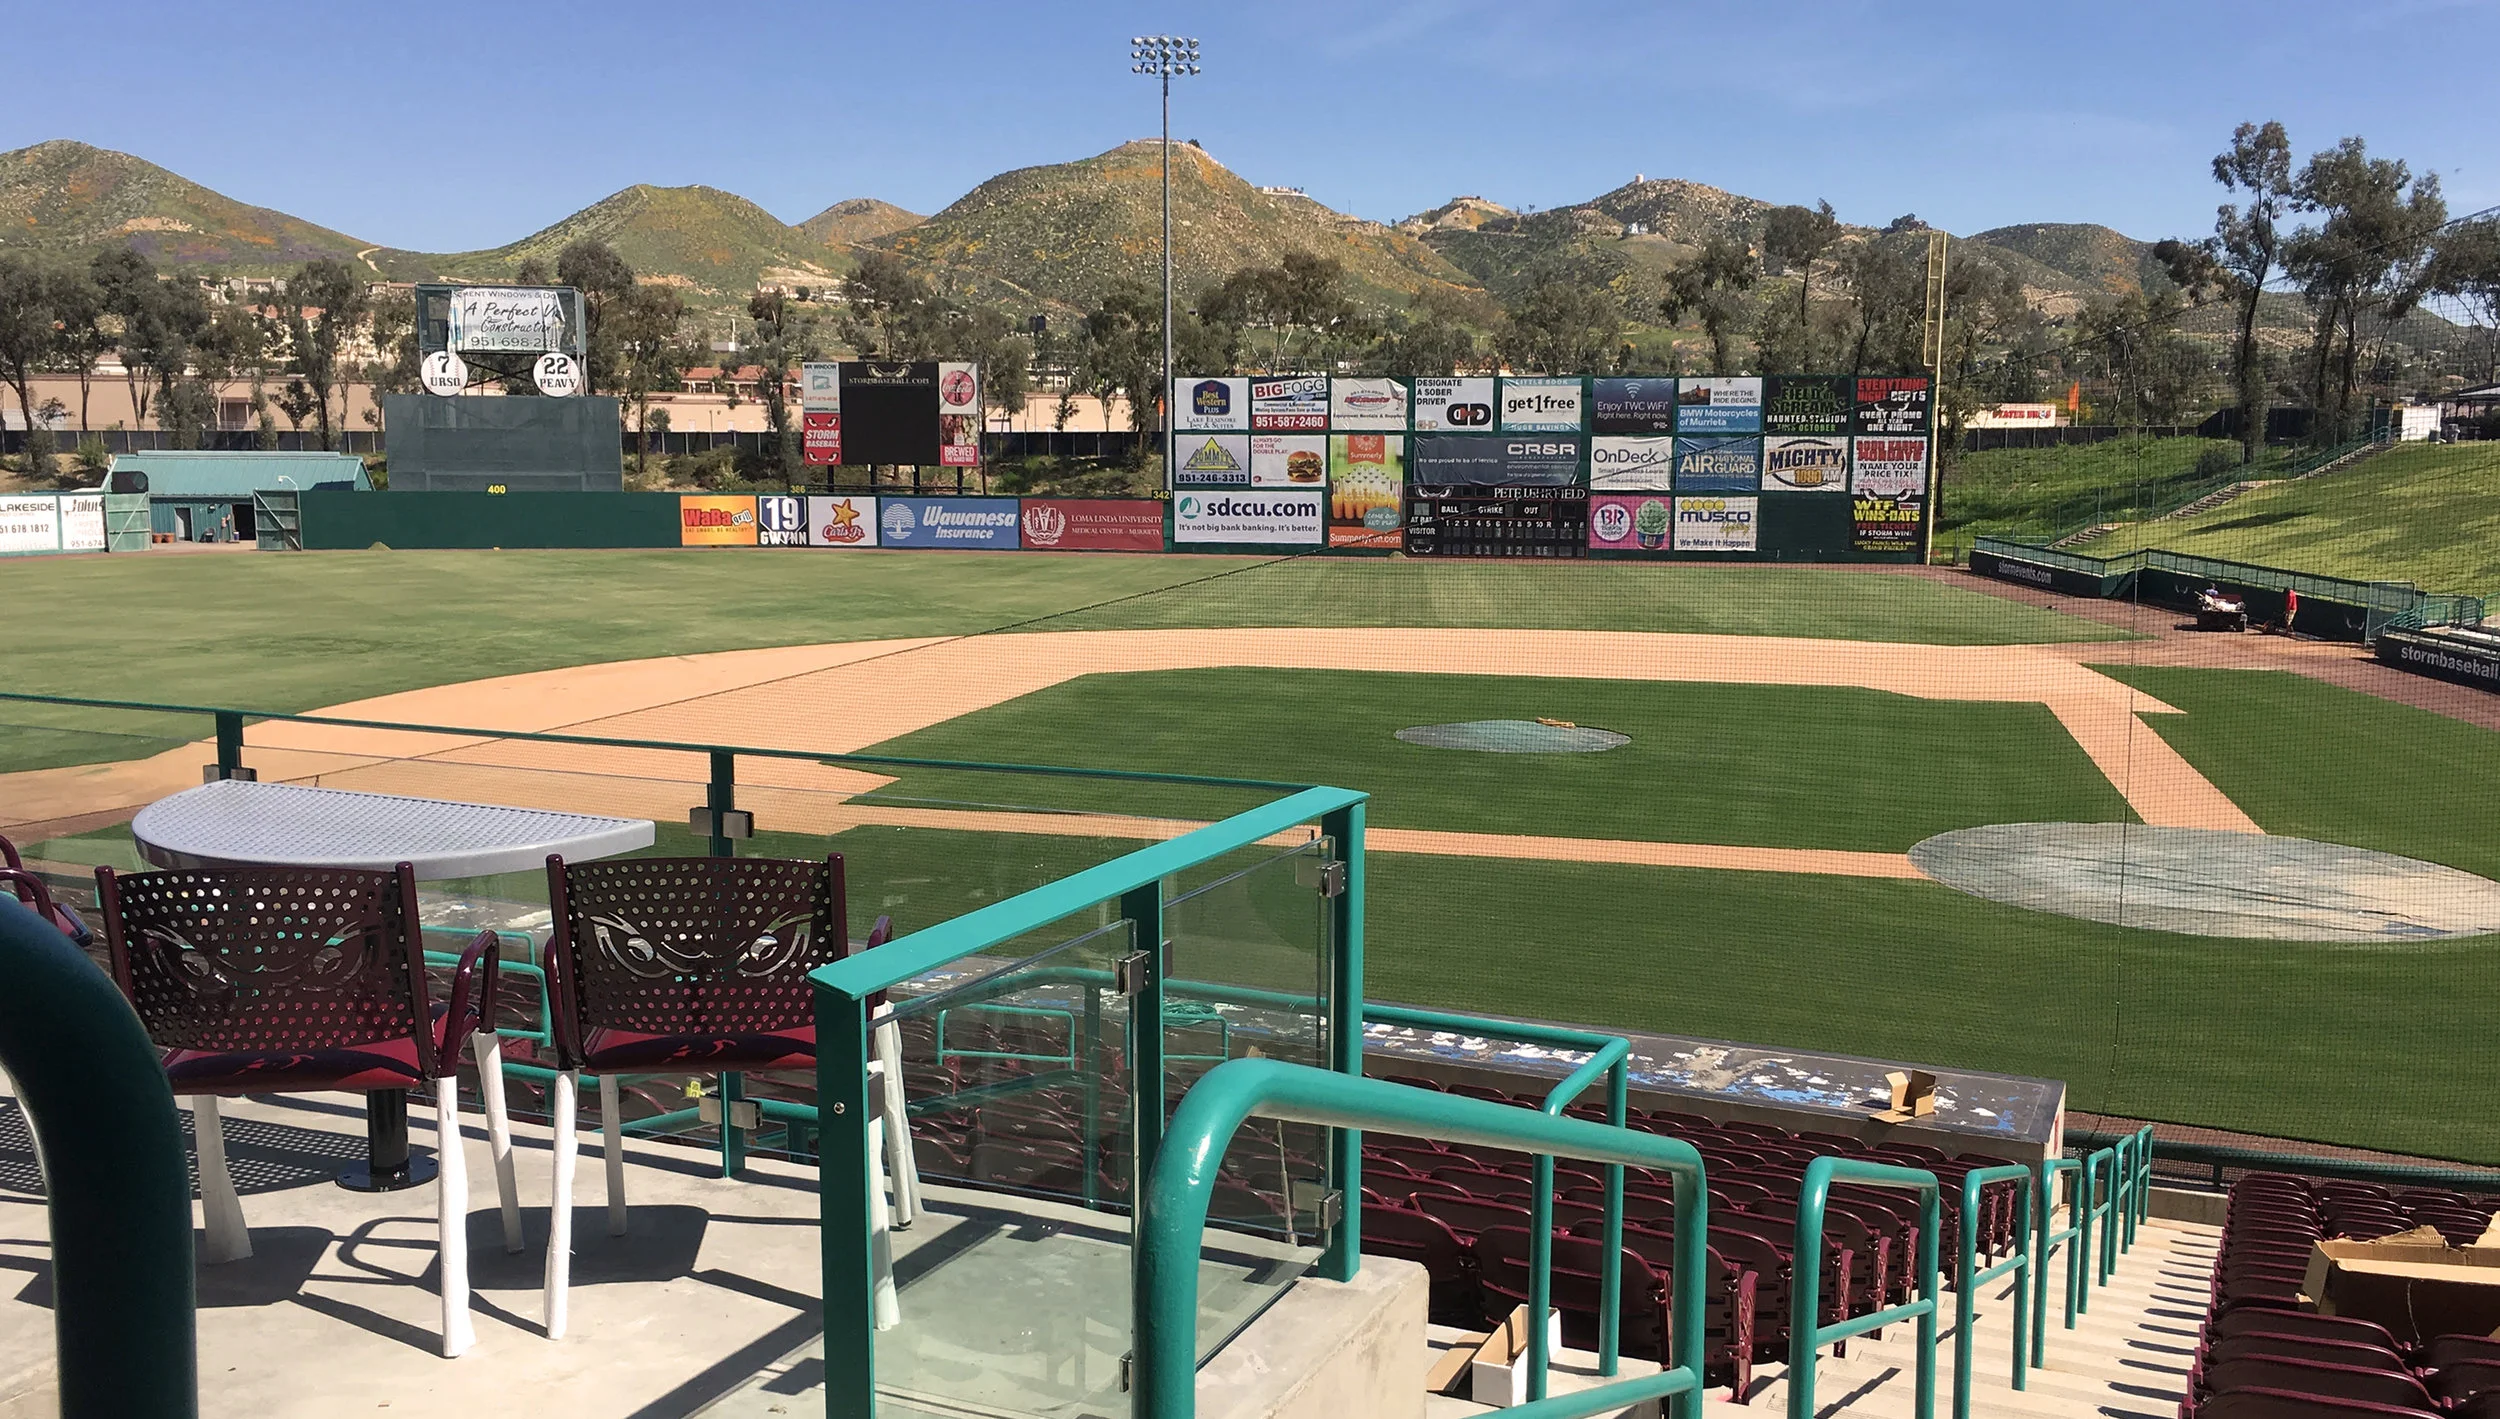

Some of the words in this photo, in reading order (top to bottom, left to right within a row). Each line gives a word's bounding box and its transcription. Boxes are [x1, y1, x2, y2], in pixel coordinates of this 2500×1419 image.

[466, 301, 477, 316] A
[482, 302, 538, 320] Perfect
[438, 356, 449, 373] 7
[544, 357, 568, 375] 22
[430, 377, 460, 386] URSO
[540, 378, 576, 388] PEAVY
[1858, 379, 1928, 391] EVERYTHING
[1202, 391, 1219, 399] Best
[1425, 388, 1452, 396] SOBER
[1196, 397, 1227, 406] Western
[1597, 402, 1622, 411] Enjoy
[1624, 402, 1645, 410] TWC
[1705, 409, 1758, 418] Motorcycles
[1767, 414, 1806, 423] HAUNTED
[1809, 414, 1847, 423] STADIUM
[1860, 411, 1888, 419] EVERY
[1891, 411, 1922, 419] PROMO
[1256, 416, 1324, 427] 951-587-2460
[1690, 418, 1727, 426] Murrieta
[805, 429, 840, 440] STORM
[805, 440, 840, 448] BASEBALL
[1507, 443, 1576, 455] CR&R
[944, 446, 975, 457] BREWED
[1594, 448, 1659, 463] OnDeck
[1680, 454, 1714, 473] AIR
[1769, 448, 1842, 470] MIGHTY
[1714, 463, 1756, 473] GUARD
[1823, 470, 1841, 481] AM
[487, 485, 506, 494] 400
[1153, 491, 1170, 499] 342
[1494, 488, 1521, 498] PETE
[1554, 489, 1586, 499] FIELD
[0, 503, 55, 512] LAKESIDE
[1207, 498, 1316, 517] sdccu.com
[1854, 500, 1894, 510] WTF
[683, 509, 732, 527] WaBa
[732, 508, 754, 526] grill
[766, 498, 799, 530] 19
[922, 506, 1017, 527] Wawanesa
[1095, 515, 1117, 523] LINDA
[1118, 515, 1163, 523] UNIVERSITY
[1854, 510, 1920, 521] WINS-DAYS
[935, 526, 994, 539] Insurance
[1207, 524, 1219, 532] big
[1242, 524, 1277, 533] banking.
[760, 532, 807, 545] GWYNN
[1330, 533, 1401, 544] SummerlyFun.com
